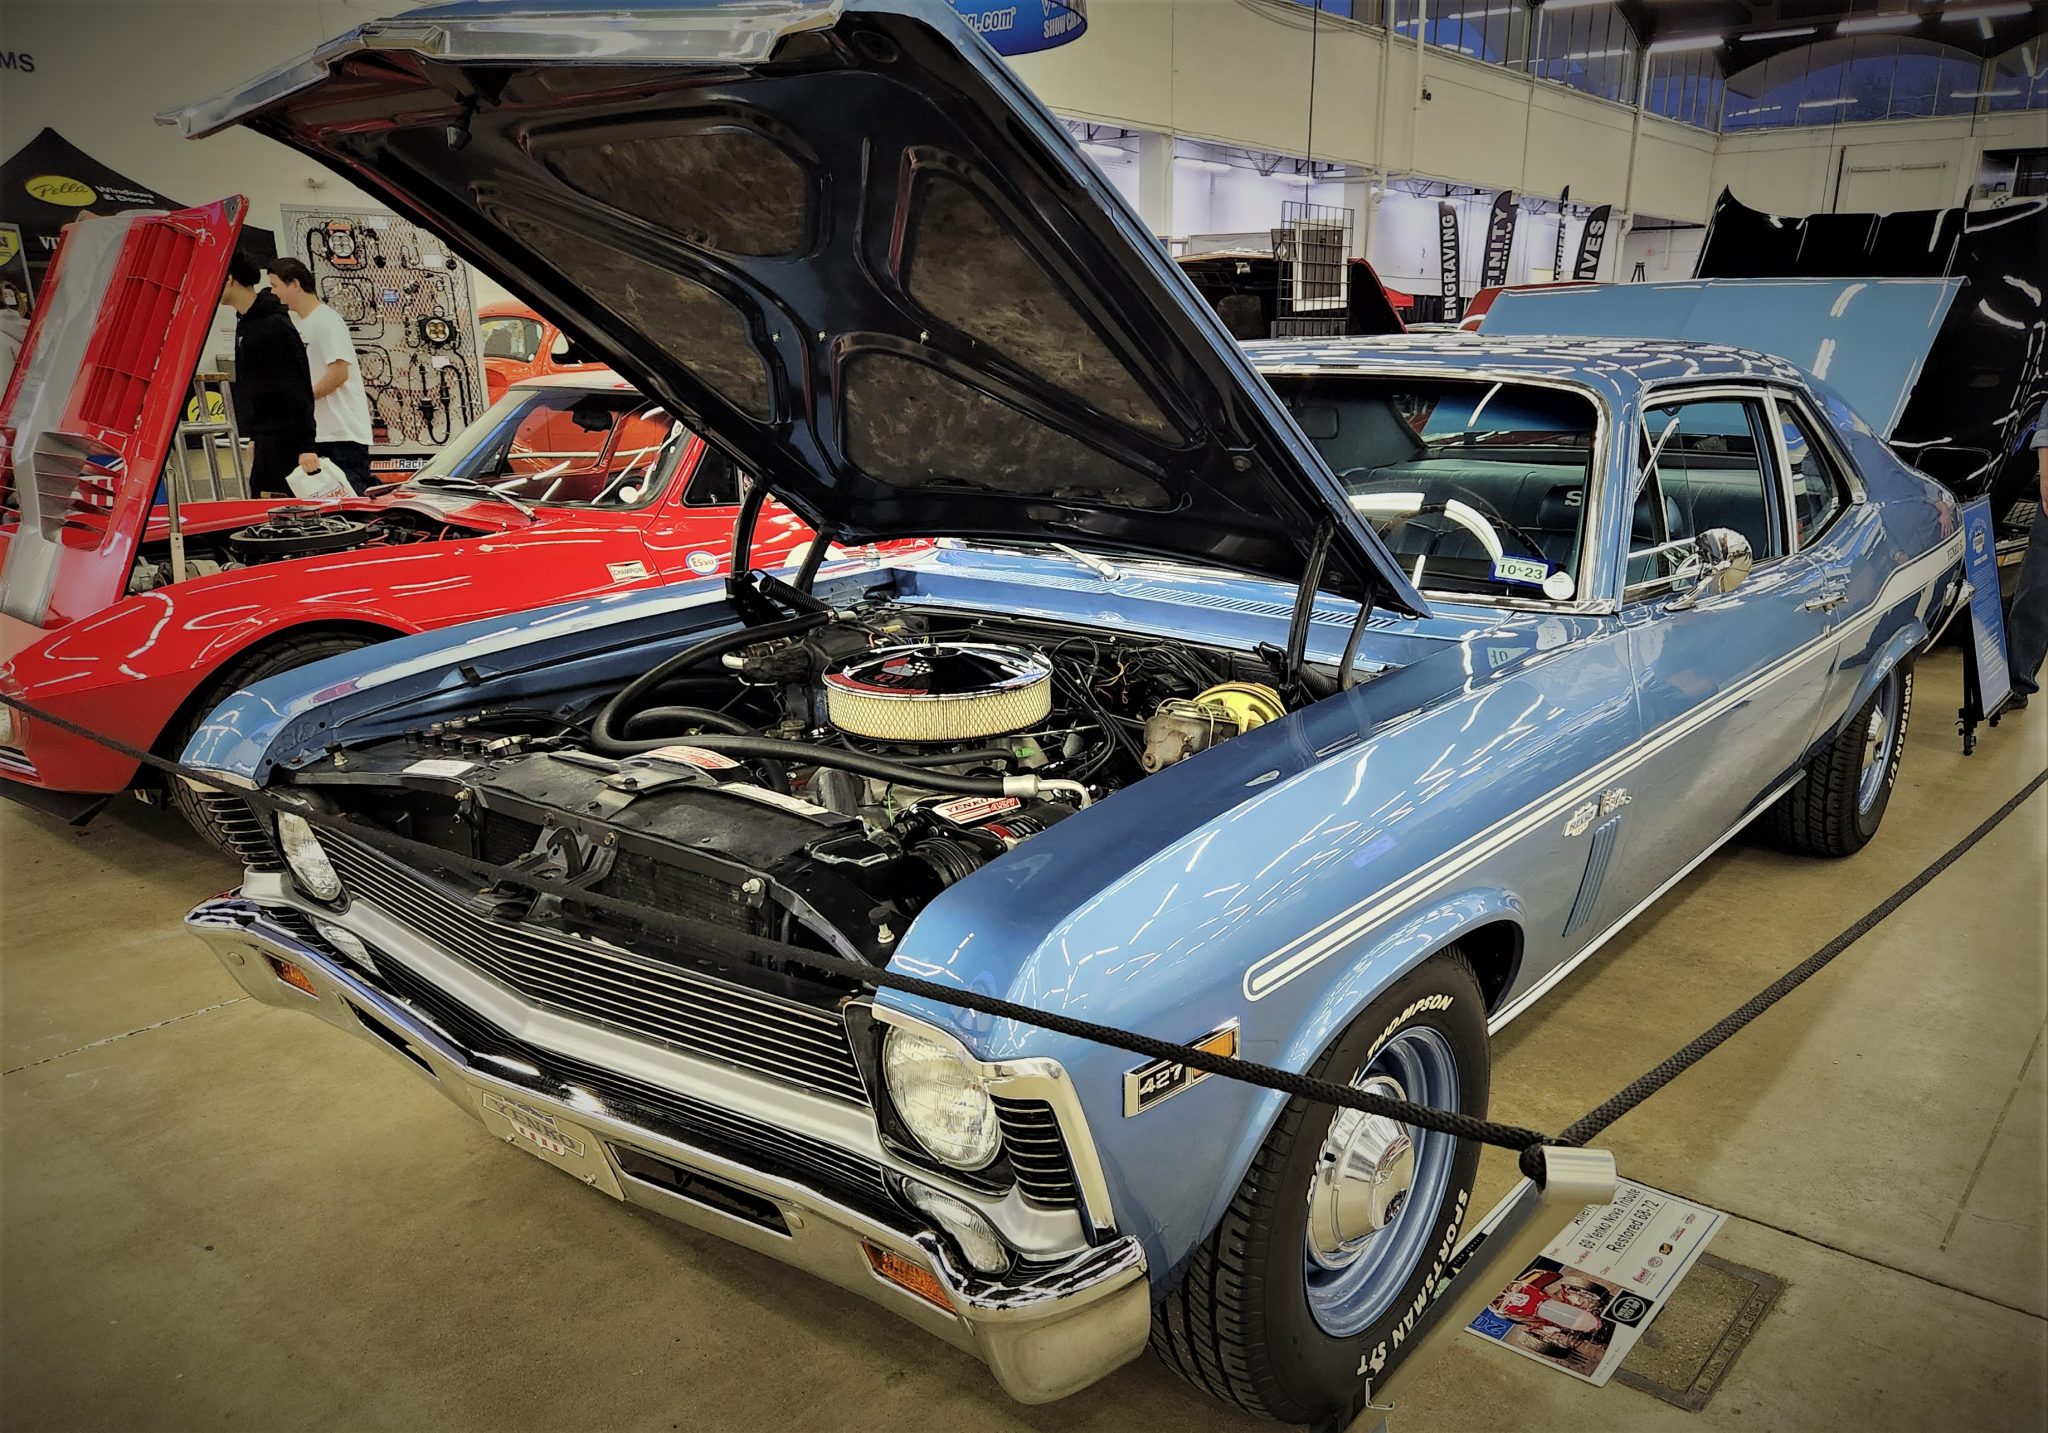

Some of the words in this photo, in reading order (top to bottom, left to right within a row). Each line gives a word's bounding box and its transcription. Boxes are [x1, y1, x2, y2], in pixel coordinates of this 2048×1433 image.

[1043, 16, 1066, 38] SHOW
[33, 182, 88, 197] Pella
[95, 185, 155, 199] Windows
[116, 194, 155, 204] Doors
[1441, 214, 1457, 320] ENGRAVING
[613, 568, 644, 576] CHAMPION
[1895, 673, 1912, 758] SPORTSMAN
[1366, 993, 1454, 1061] THOMPSON
[1140, 1063, 1183, 1095] 427
[491, 1098, 576, 1149] YENKO
[1613, 1188, 1641, 1215] Tribute
[1604, 1206, 1625, 1226] Nova
[1606, 1216, 1644, 1254] Restored
[1634, 1200, 1661, 1222] 68-72
[1587, 1219, 1611, 1245] Yenko
[1391, 1188, 1468, 1350] SPORTSMAN
